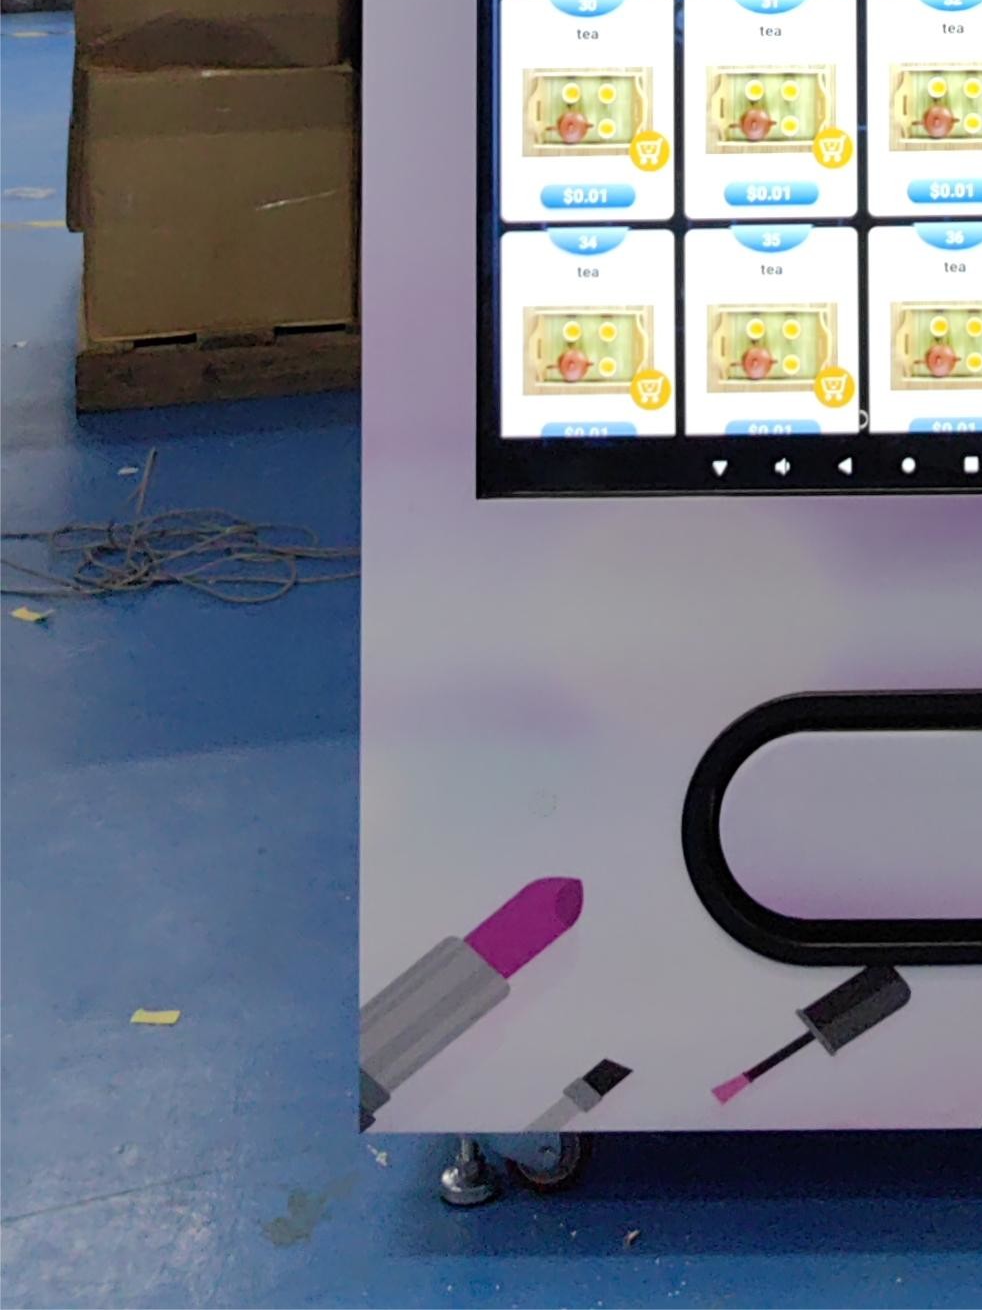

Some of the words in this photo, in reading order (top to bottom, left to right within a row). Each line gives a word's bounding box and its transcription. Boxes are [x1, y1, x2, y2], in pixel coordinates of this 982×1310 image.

[760, 26, 781, 37] tea
[943, 23, 964, 34] tea
[577, 29, 598, 40] tea
[564, 187, 607, 204] $0.01
[747, 185, 790, 202] $0.01
[930, 183, 974, 200] $0.01
[578, 236, 597, 250] 34
[762, 234, 781, 247] 35
[946, 231, 964, 244] 36
[578, 267, 599, 278] tea
[761, 265, 782, 275] tea
[945, 262, 966, 273] tea
[565, 426, 608, 436] $001
[748, 424, 791, 434] $001
[932, 422, 975, 432] $001
